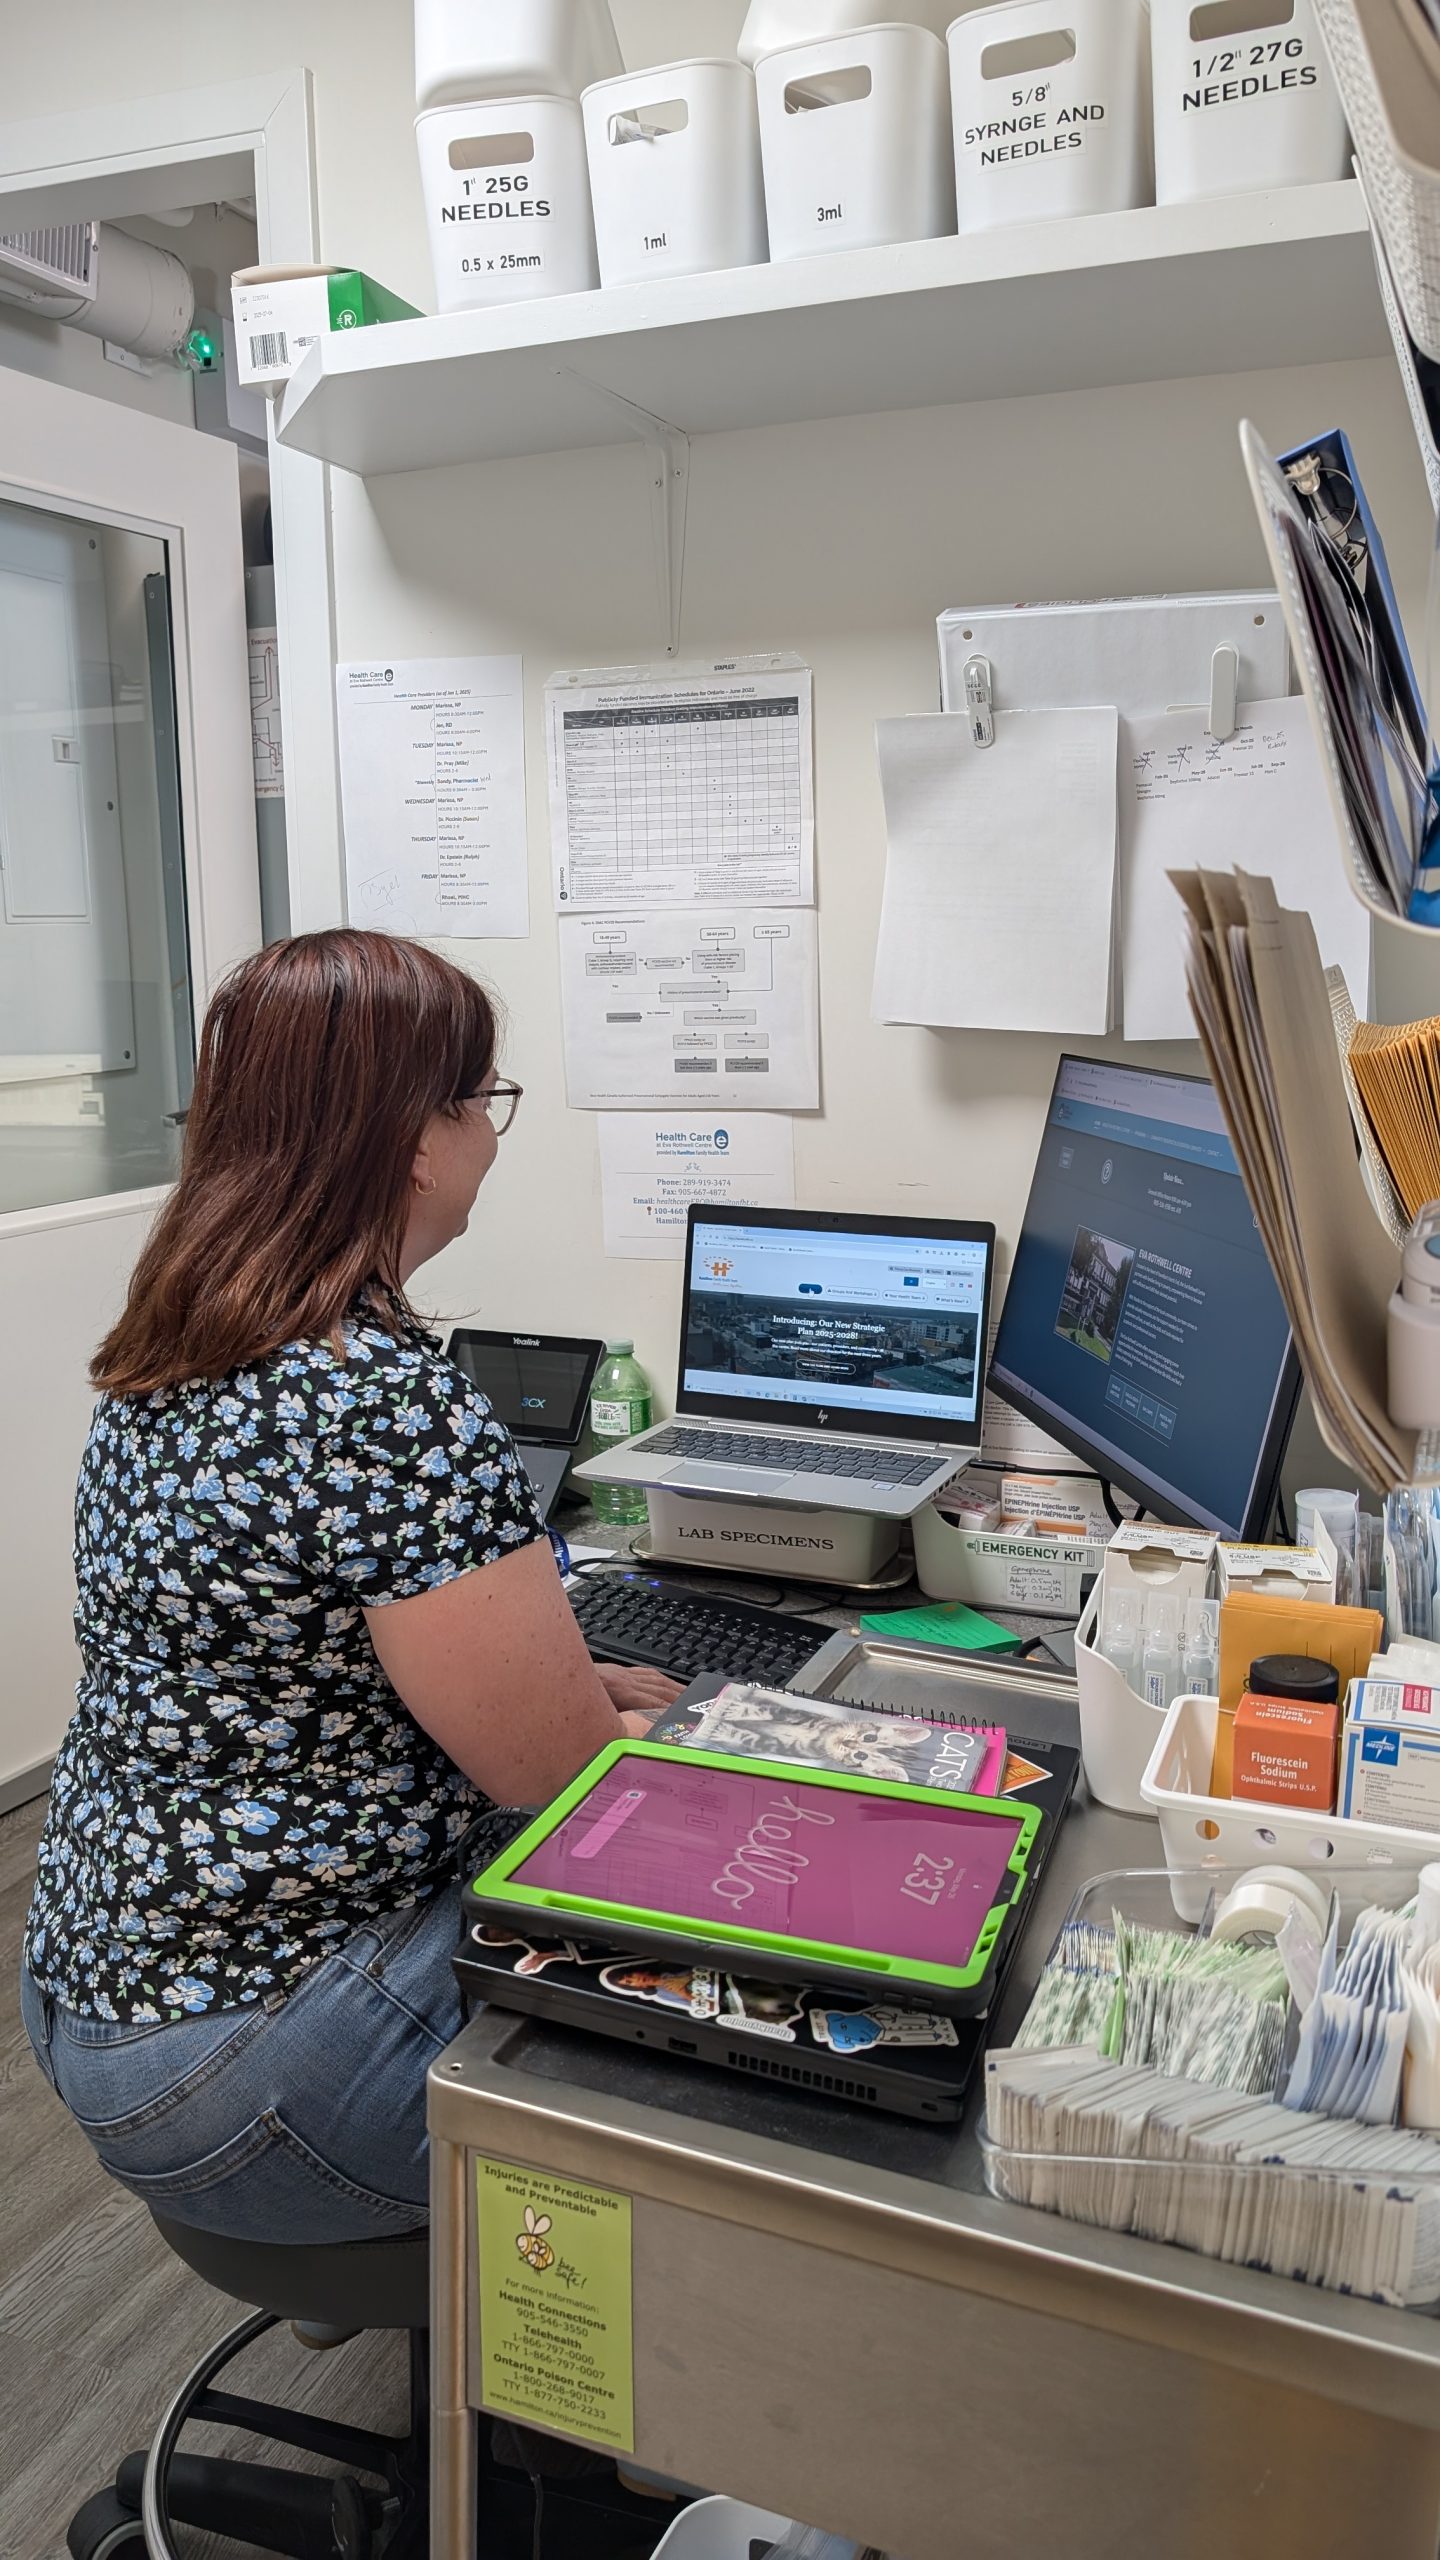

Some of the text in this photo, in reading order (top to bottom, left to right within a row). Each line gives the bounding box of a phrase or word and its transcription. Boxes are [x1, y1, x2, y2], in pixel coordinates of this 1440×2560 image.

[1250, 38, 1303, 66] 27G
[1183, 66, 1317, 111] NEEDLES
[965, 104, 1105, 145] SYRNGE AND
[981, 132, 1082, 166] NEEDLES
[485, 175, 529, 194] 25G
[441, 199, 550, 223] NEEDLES
[817, 204, 842, 223] 3ml
[643, 233, 667, 251] 1ml
[461, 253, 541, 273] 0.5 x 25mm
[251, 637, 278, 645] Evacuatio
[256, 785, 279, 793] mergency
[656, 1132, 687, 1141] Health
[689, 1132, 712, 1141] Care
[657, 1178, 681, 1186] Phone:
[1148, 1252, 1172, 1271] ROTHWELL
[1172, 1261, 1193, 1278] CENTRE
[772, 1314, 886, 1334] Introducing: Our New Strategic
[797, 1327, 858, 1340] Plan 2025-2028!
[513, 1337, 540, 1347] Yealink
[521, 1397, 546, 1409] 3CX
[817, 1409, 829, 1423] hp
[1004, 1499, 1080, 1512] EPINEPHrine Injection USP
[1004, 1506, 1029, 1515] Injection
[678, 1527, 834, 1550] LAB SPECIMENS
[982, 1541, 1085, 1563] EMERGENCY KIT
[1255, 1711, 1312, 1725] Fluorescein
[1267, 1707, 1303, 1717] Sodium
[1007, 1736, 1049, 1750] Lenov
[1365, 1741, 1396, 1752] MEDLINE
[929, 1732, 975, 1780] CATS
[1251, 1752, 1308, 1769] Fluorescein
[1240, 1774, 1277, 1786] Ophthalmic
[1278, 1781, 1298, 1791] Strips
[1260, 1765, 1297, 1779] Sodium
[712, 1796, 836, 1910] hello
[900, 1852, 954, 1906] 2:37
[484, 2165, 618, 2210] Injuries are Predictable
[505, 2184, 597, 2216] and Preventable
[505, 2278, 600, 2314] For more information:
[499, 2290, 607, 2331] Health Connections
[516, 2307, 589, 2337] 905-546-3550
[523, 2323, 582, 2350] Telehealth
[513, 2332, 594, 2366] 1-866-797-0000
[502, 2340, 605, 2380] TTY 1-866-797-0007
[494, 2353, 615, 2400] Ontario Poison Centre
[513, 2372, 595, 2404] 1-800-268-9017
[502, 2378, 606, 2420] TTY 1-877-750-2233
